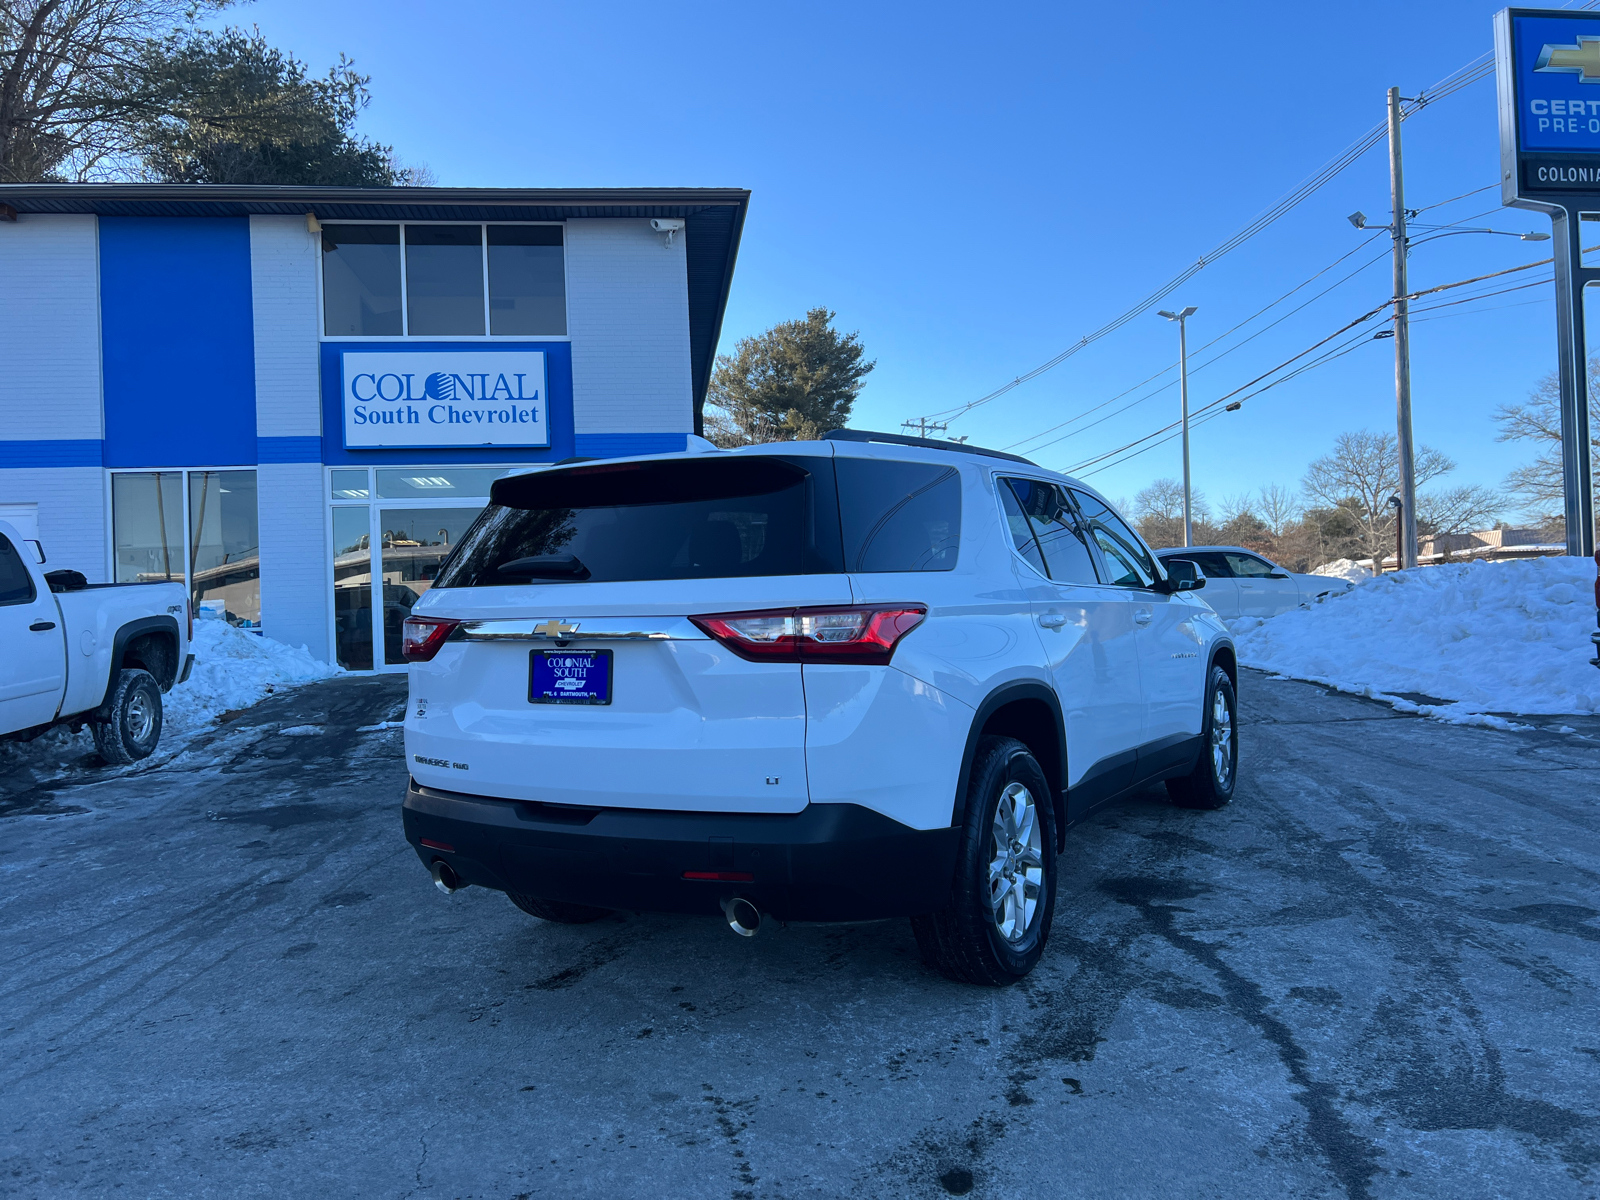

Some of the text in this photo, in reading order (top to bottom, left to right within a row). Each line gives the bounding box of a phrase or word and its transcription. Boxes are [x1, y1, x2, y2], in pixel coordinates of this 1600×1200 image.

[351, 372, 539, 402] COLONIAL
[353, 404, 539, 425] South Chevrolet
[547, 658, 594, 667] COLONIAL
[554, 668, 586, 677] SOUTH
[413, 753, 469, 770] TRAVERSE AWD
[766, 775, 782, 785] LT
